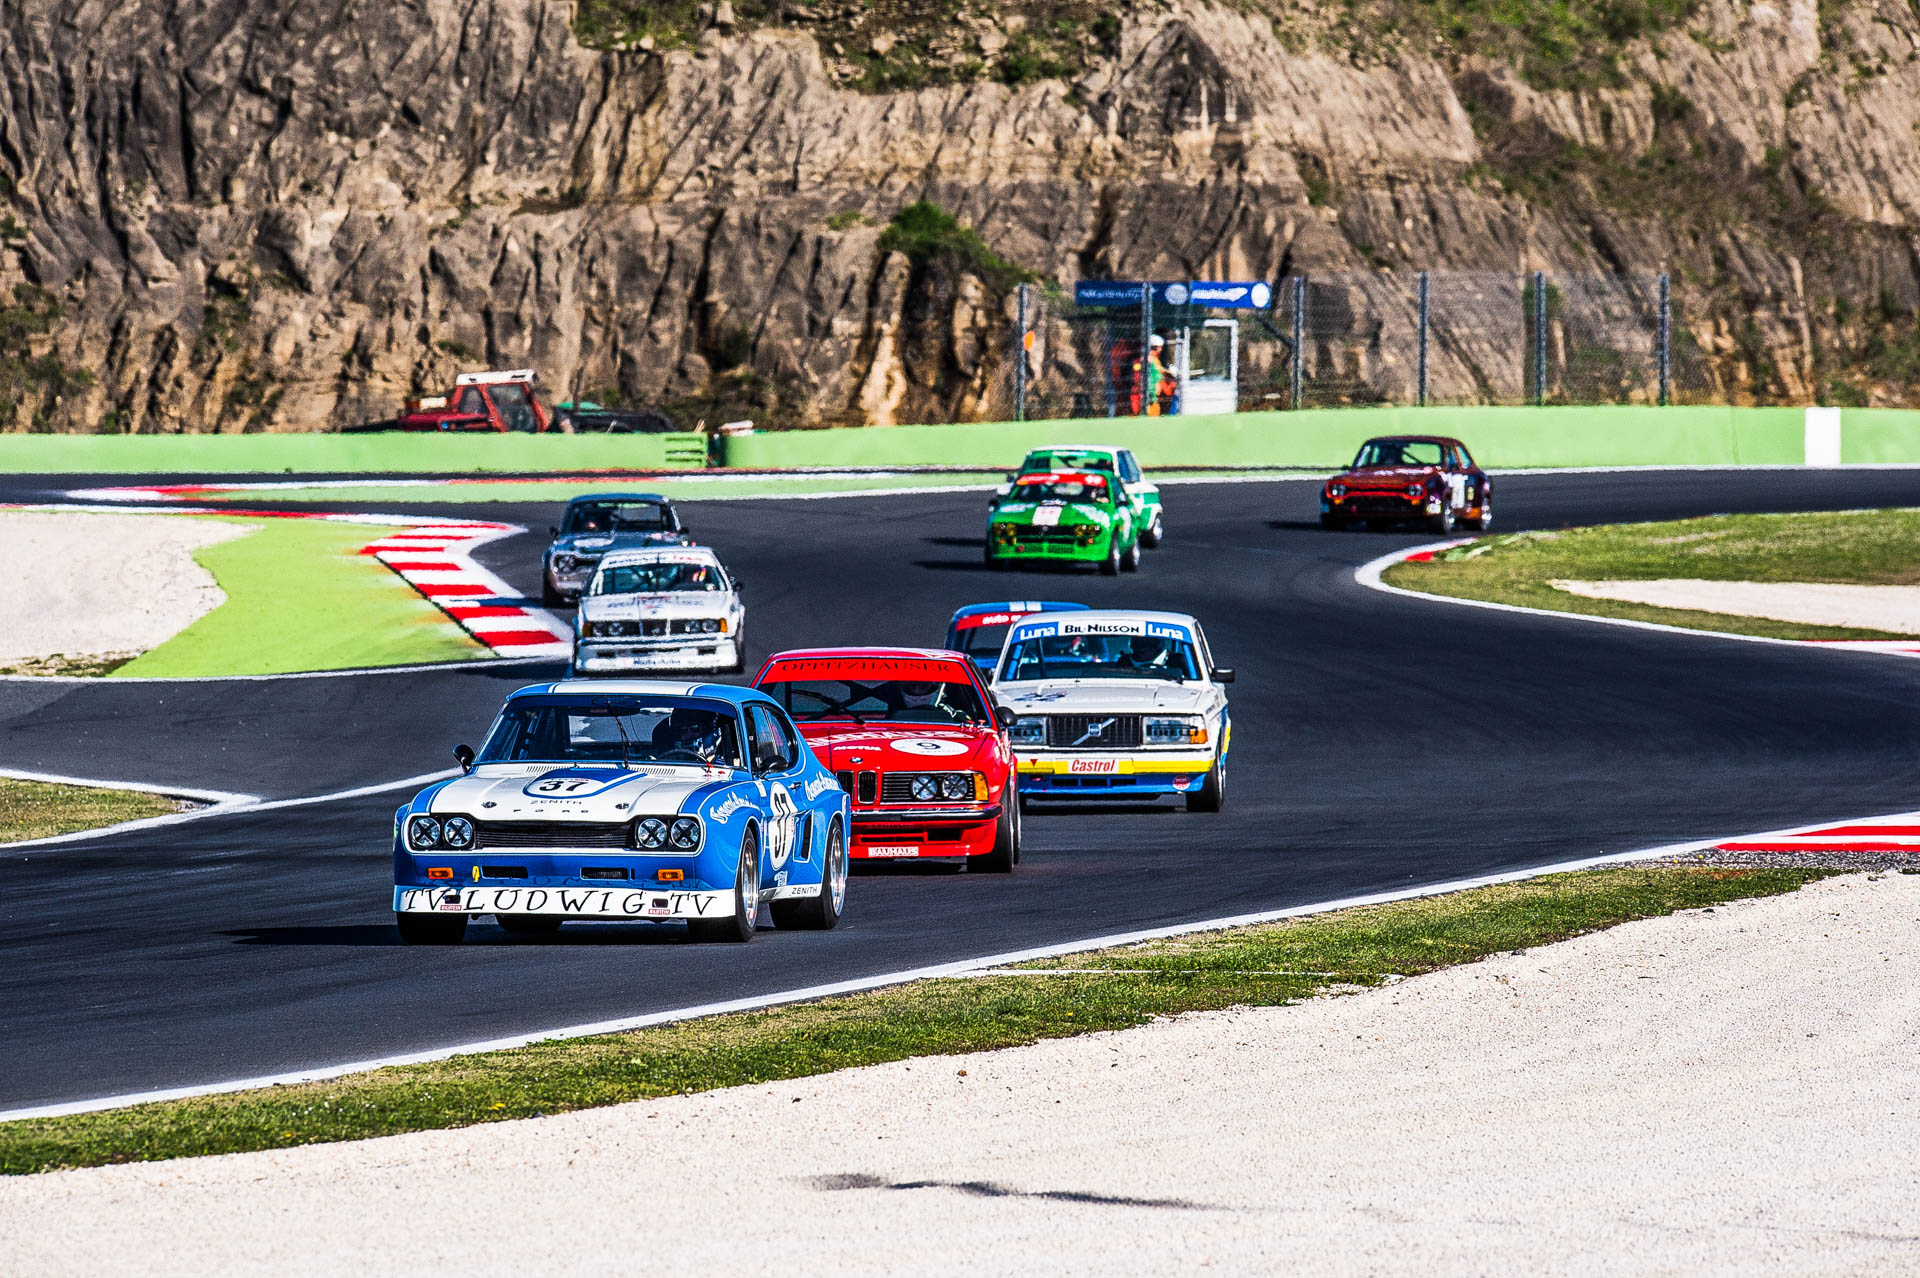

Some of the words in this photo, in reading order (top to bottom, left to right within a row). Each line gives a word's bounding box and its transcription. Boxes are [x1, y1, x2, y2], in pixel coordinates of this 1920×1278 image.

[1020, 627, 1056, 641] Luna
[1147, 624, 1184, 640] Luna
[782, 661, 951, 672] OPPITZHAUSER
[833, 744, 881, 752] MOTUL
[916, 742, 941, 750] 9
[1071, 760, 1116, 772] Castrol
[539, 781, 589, 792] 37
[774, 793, 790, 859] 37
[870, 848, 918, 857] BAUHAUS
[791, 887, 817, 895] ZENITH
[405, 888, 451, 912] TV
[463, 889, 646, 915] LUDWIG
[670, 893, 717, 916] TV
